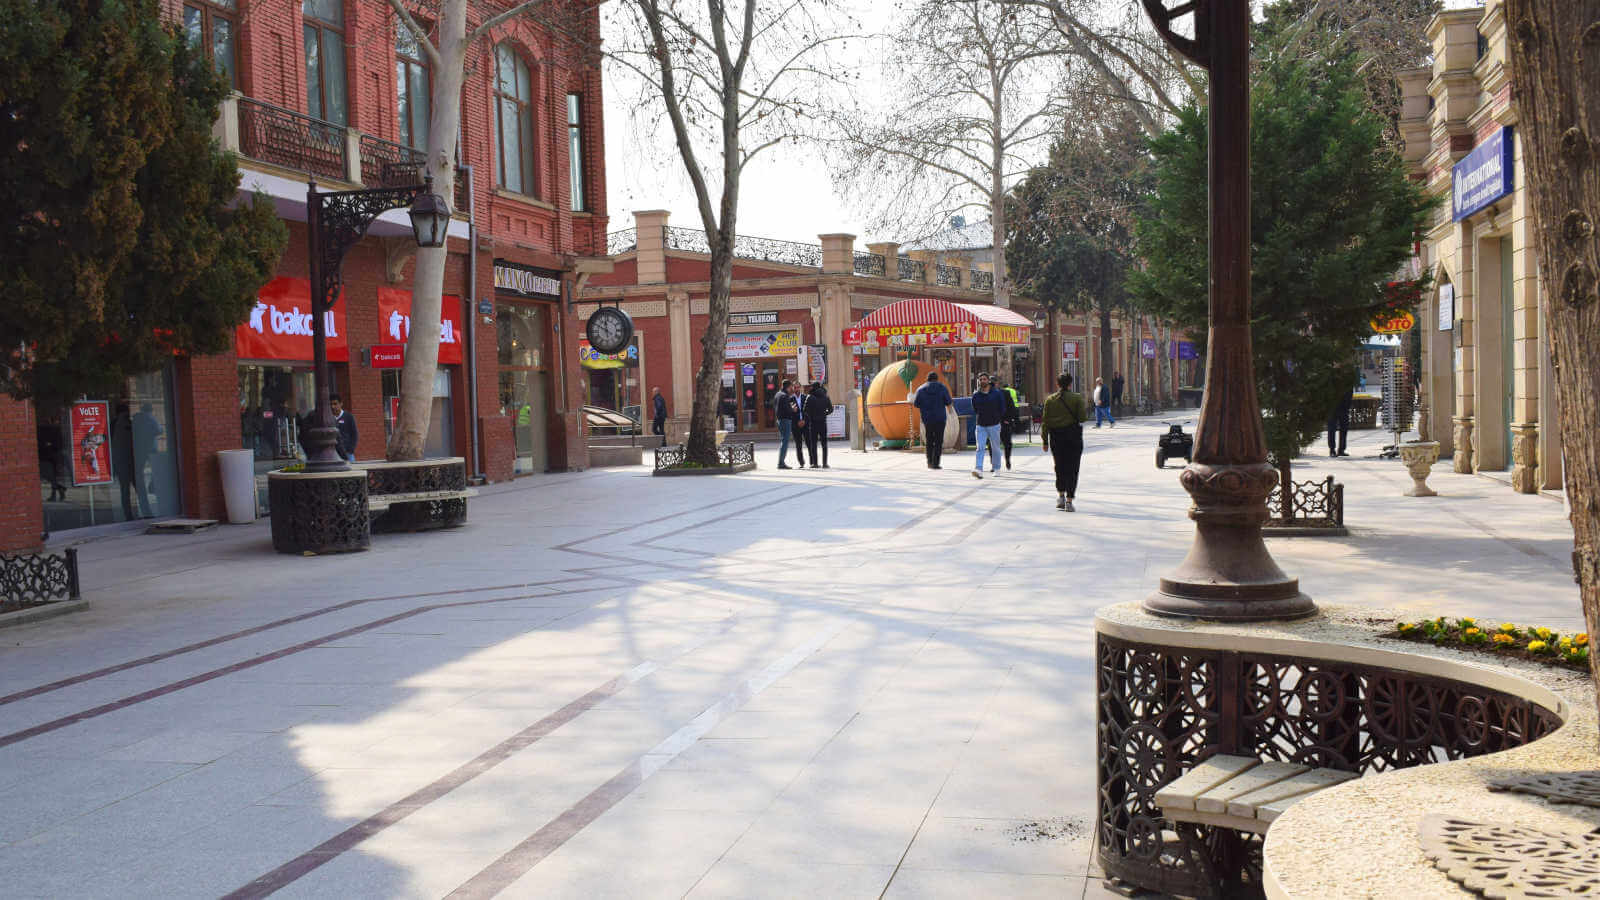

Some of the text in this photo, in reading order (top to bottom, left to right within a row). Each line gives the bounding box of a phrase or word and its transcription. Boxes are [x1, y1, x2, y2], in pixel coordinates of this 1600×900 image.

[270, 305, 338, 337] bakcll
[748, 314, 777, 324] TELEKOM
[879, 324, 956, 336] KOKTEYL
[989, 324, 1019, 343] KOKTEYL
[79, 407, 99, 416] VoLTE
